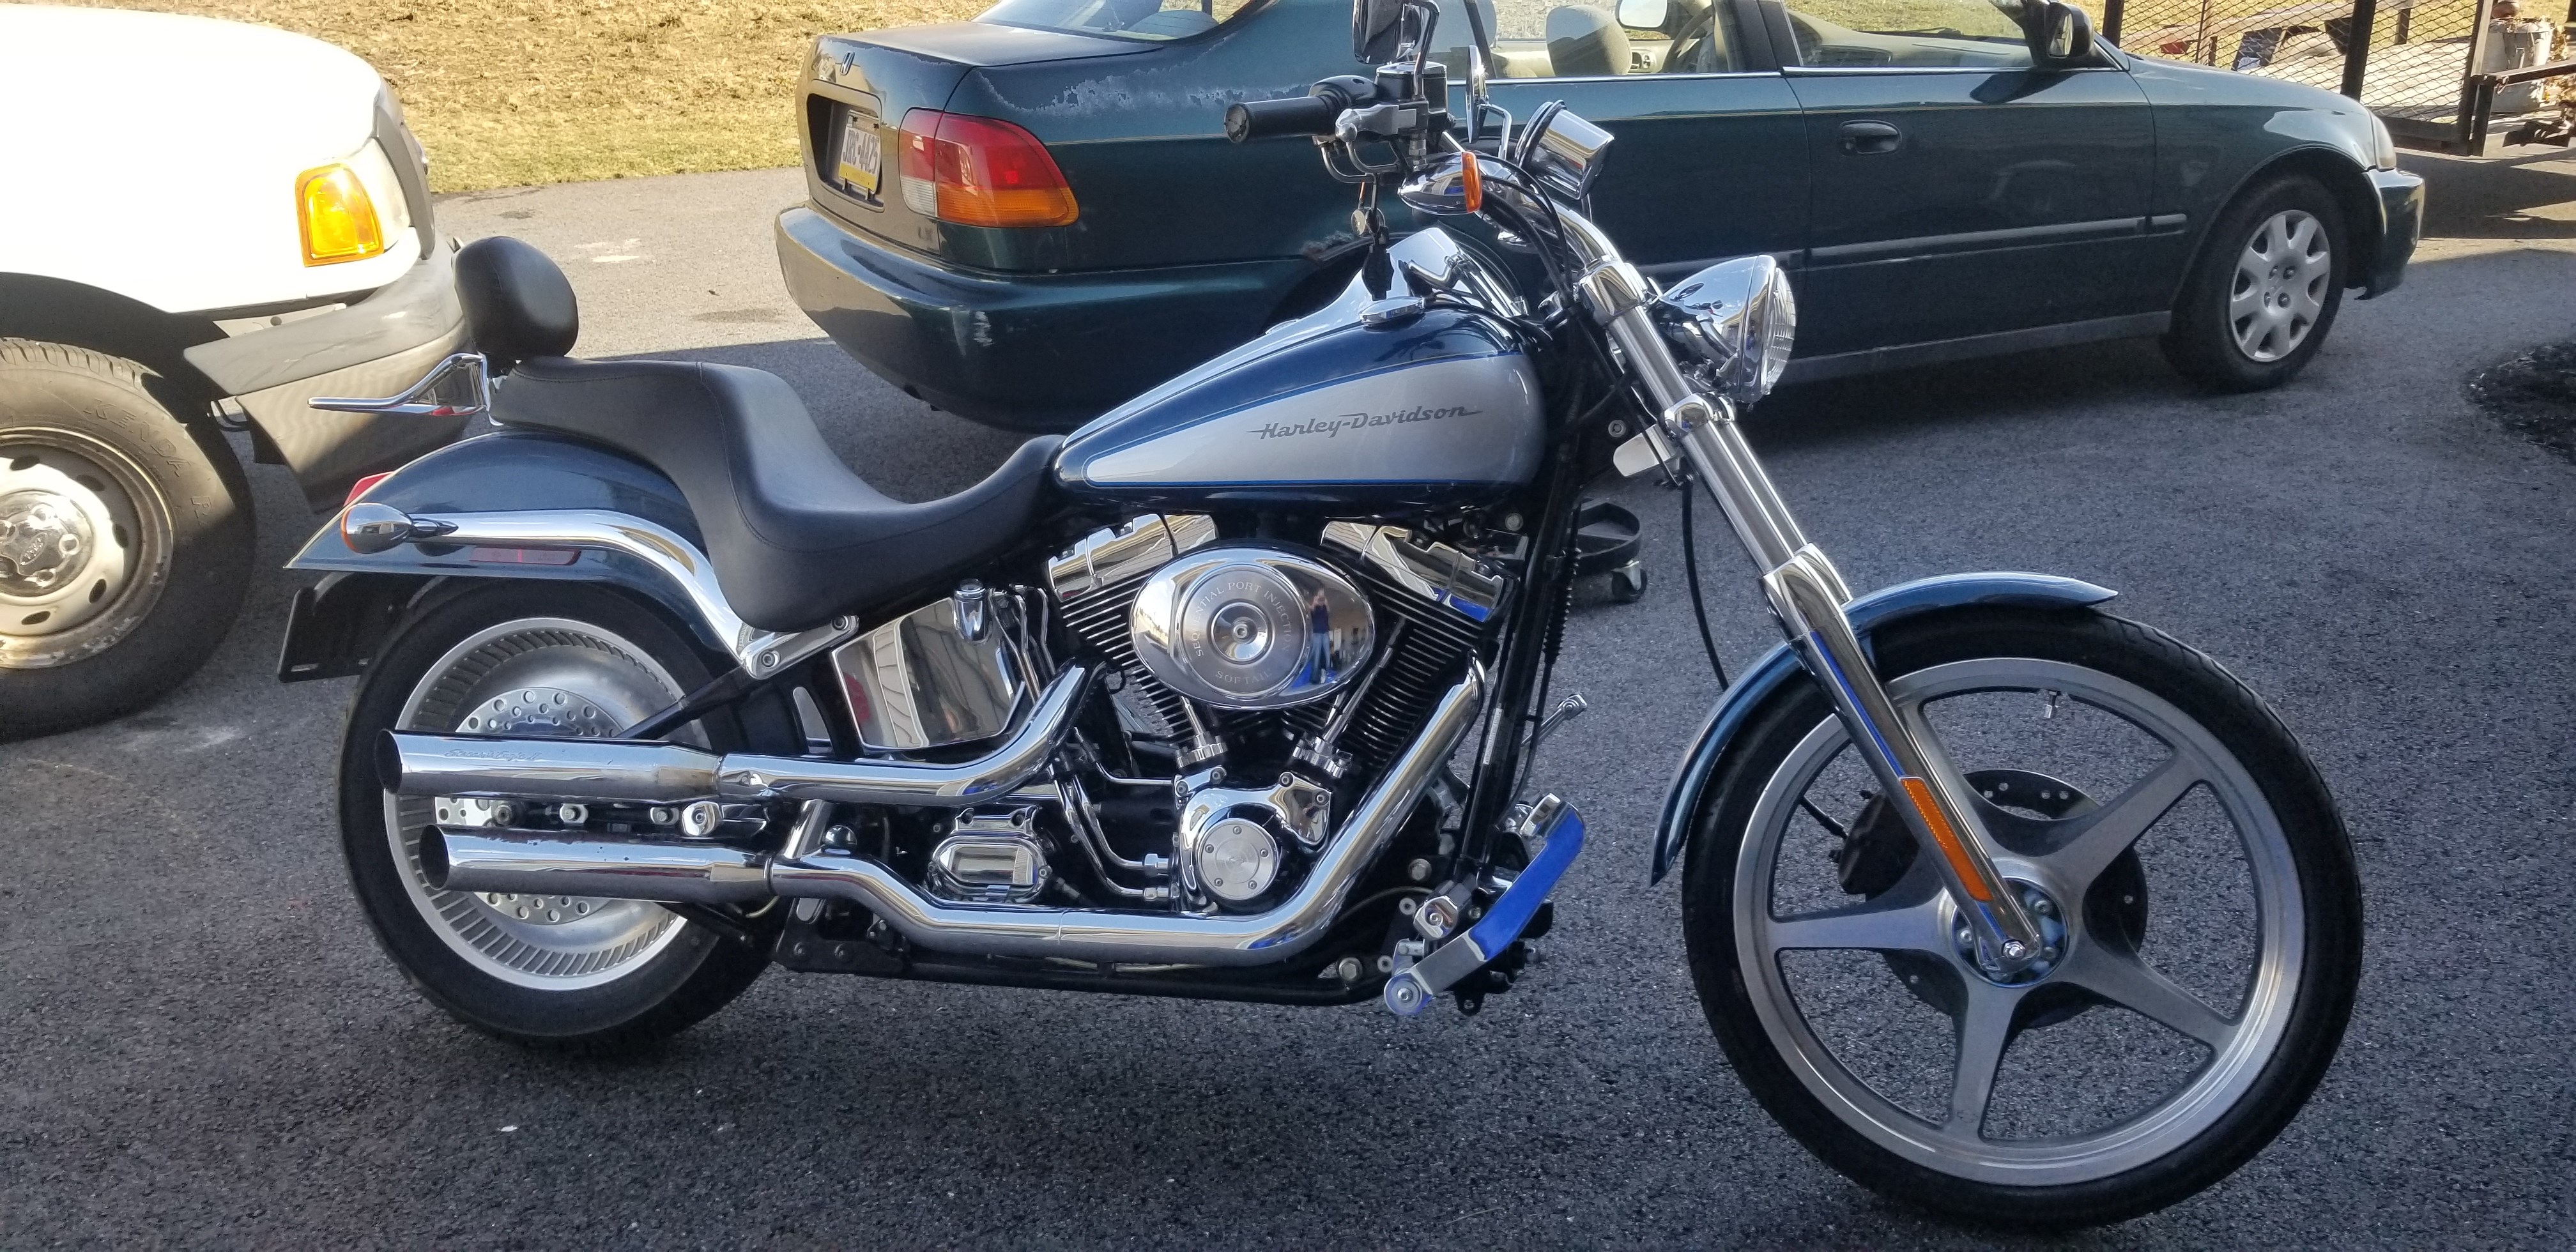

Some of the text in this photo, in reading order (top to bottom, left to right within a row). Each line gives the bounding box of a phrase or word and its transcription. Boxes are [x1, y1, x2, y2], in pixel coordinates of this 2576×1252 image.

[83, 397, 191, 478] KENDA
[1246, 406, 1483, 439] Harley-Davidson
[1191, 581, 1292, 657] SEQUENTIAL PORT INJECTION
[1215, 670, 1273, 685] SOFTAIL
